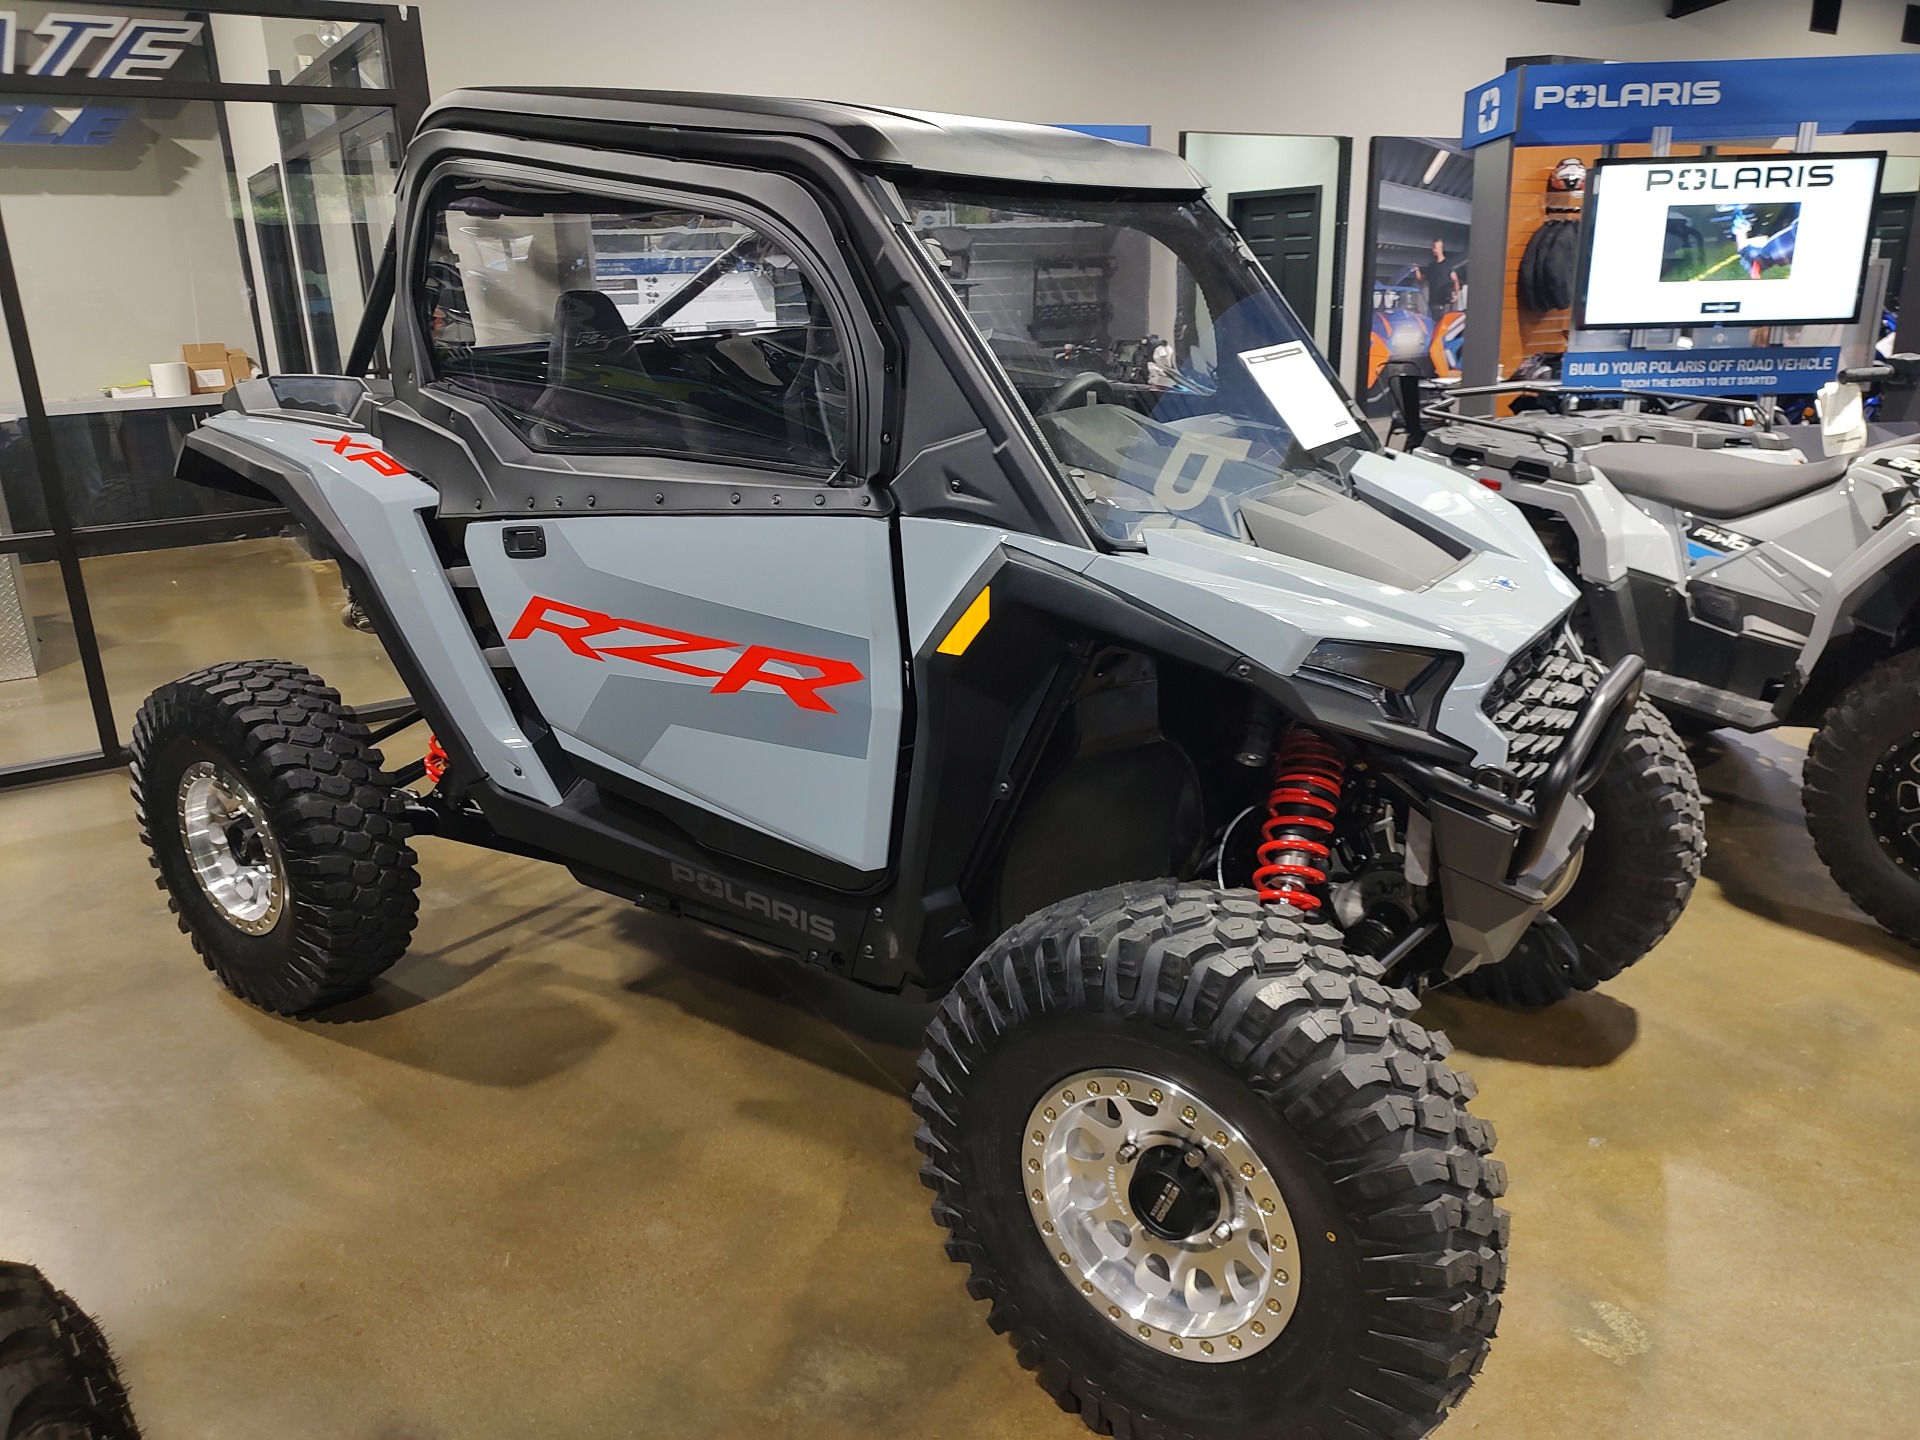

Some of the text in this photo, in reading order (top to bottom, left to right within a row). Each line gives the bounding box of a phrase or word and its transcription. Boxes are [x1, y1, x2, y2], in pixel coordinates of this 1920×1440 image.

[0, 11, 204, 80] TE
[1534, 81, 1721, 110] POLARIS
[0, 104, 134, 145] LE
[1646, 165, 1834, 191] POLARIS
[1568, 357, 1833, 376] BUILD YOUR POLARIS OFF ROAD VEHICLE
[1620, 375, 1777, 388] TOUCH THE SCREEN TO GET STARTED
[310, 434, 409, 477] XP
[507, 595, 866, 715] RZR
[670, 862, 836, 944] POLARIS
